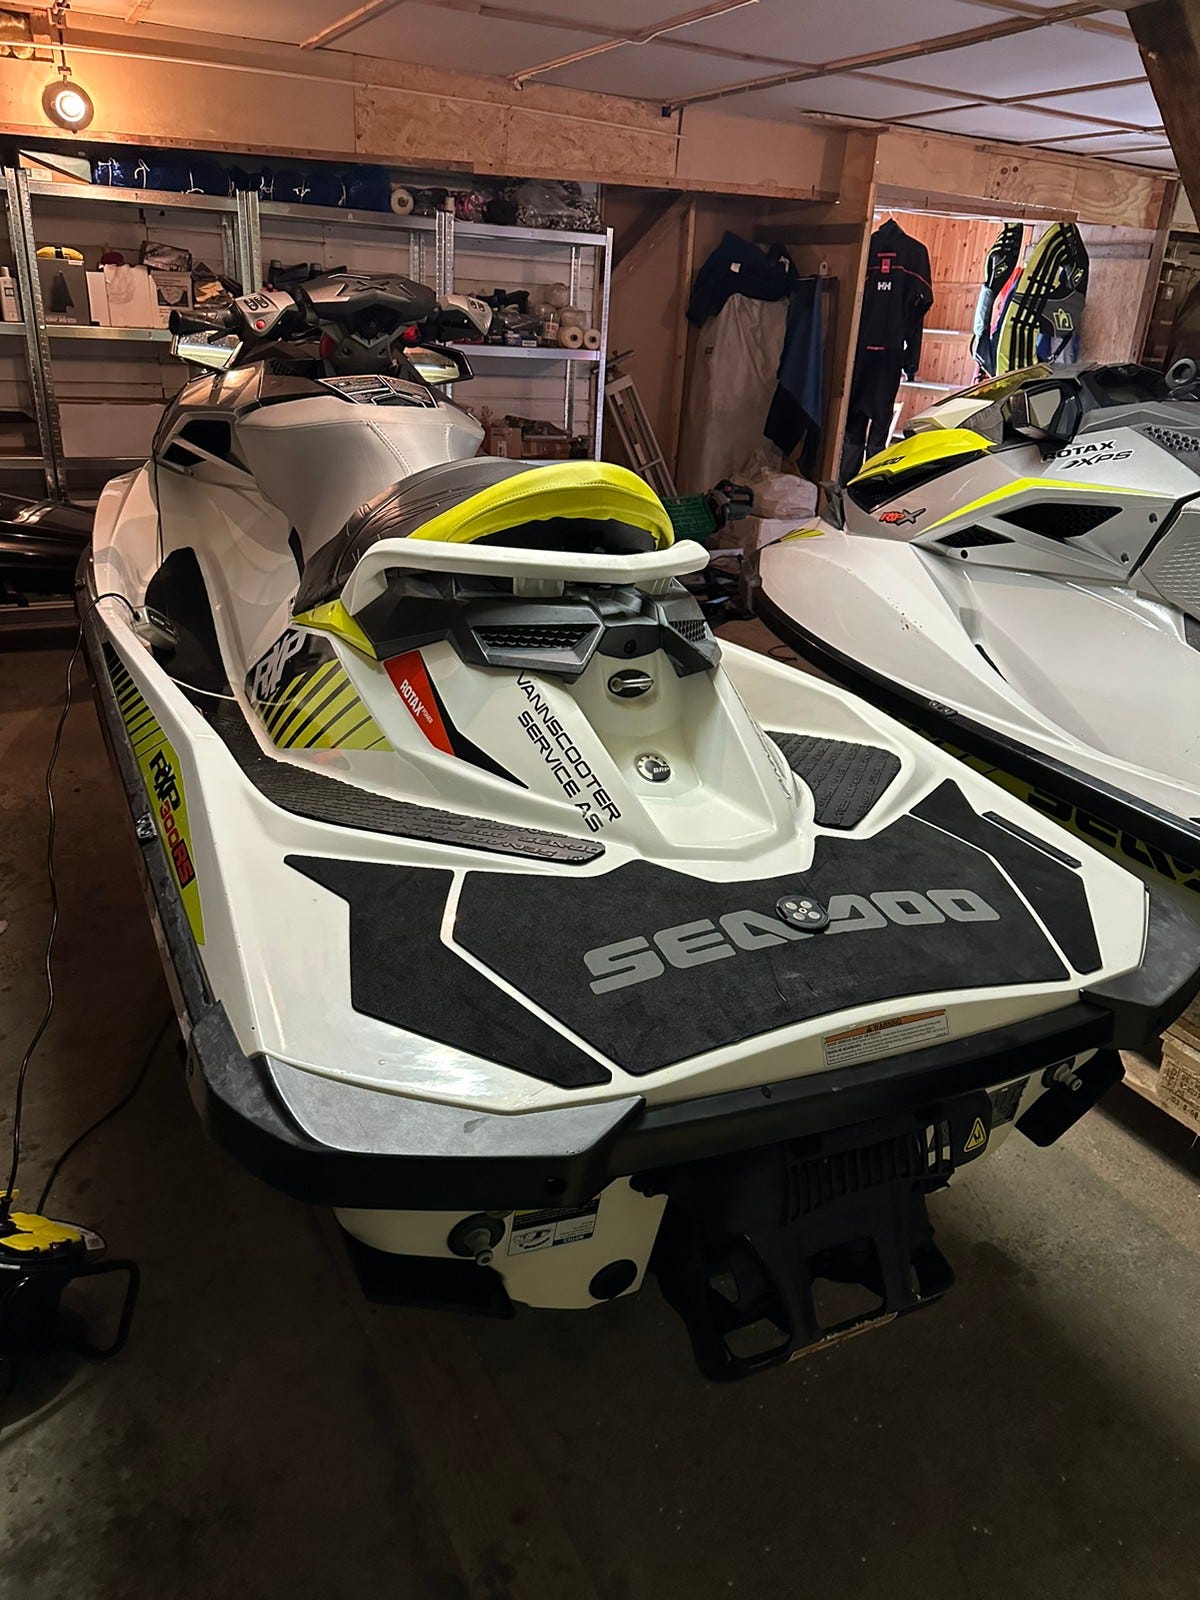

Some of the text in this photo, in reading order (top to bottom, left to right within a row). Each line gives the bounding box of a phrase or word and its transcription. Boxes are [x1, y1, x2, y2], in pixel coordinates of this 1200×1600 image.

[877, 281, 892, 291] HH
[1043, 440, 1115, 462] ROTAX
[400, 679, 425, 717] ROTAX
[516, 671, 622, 822] VANNSCOOTER
[517, 710, 581, 799] SERVICE
[574, 802, 604, 833] AS
[653, 766, 670, 774] BRP
